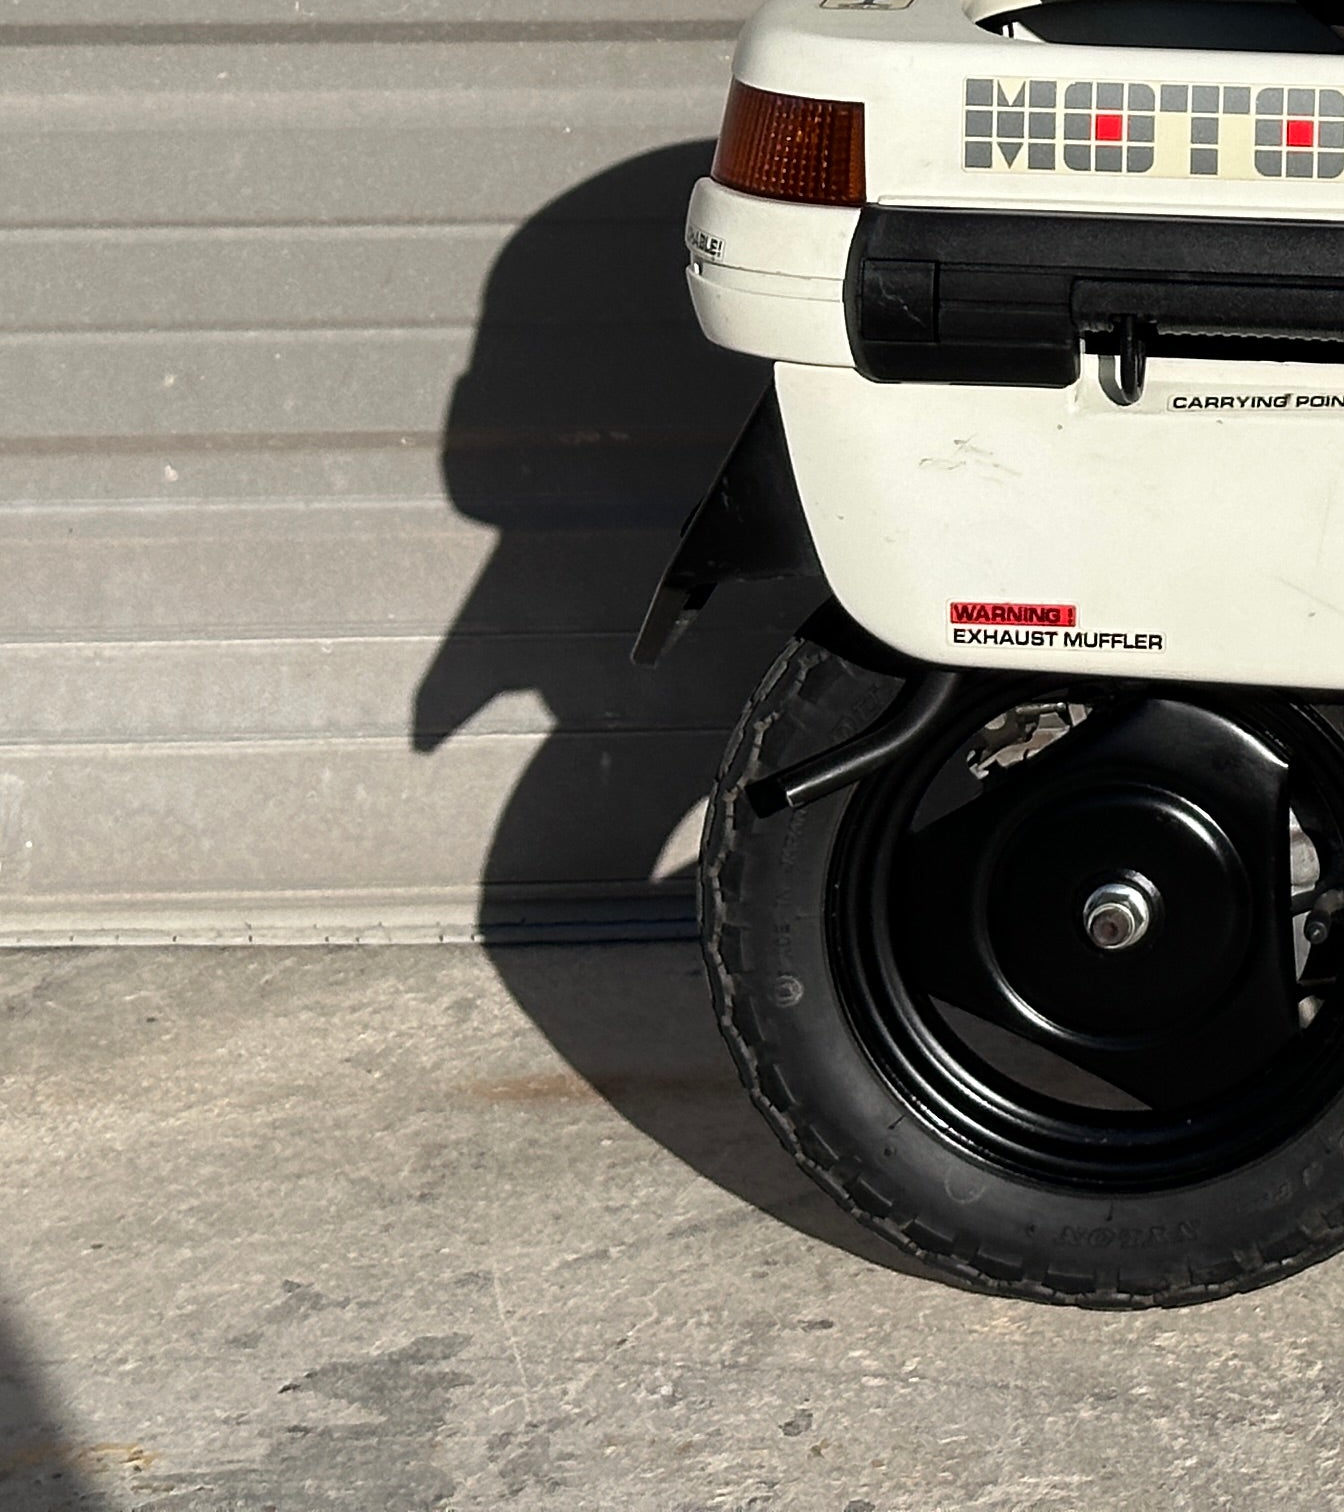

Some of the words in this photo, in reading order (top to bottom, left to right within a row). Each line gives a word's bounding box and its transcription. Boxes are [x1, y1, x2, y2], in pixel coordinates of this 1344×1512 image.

[1172, 395, 1288, 409] CARRYING
[953, 628, 1058, 647] EXHAUST
[1063, 632, 1163, 650] MUFFLER
